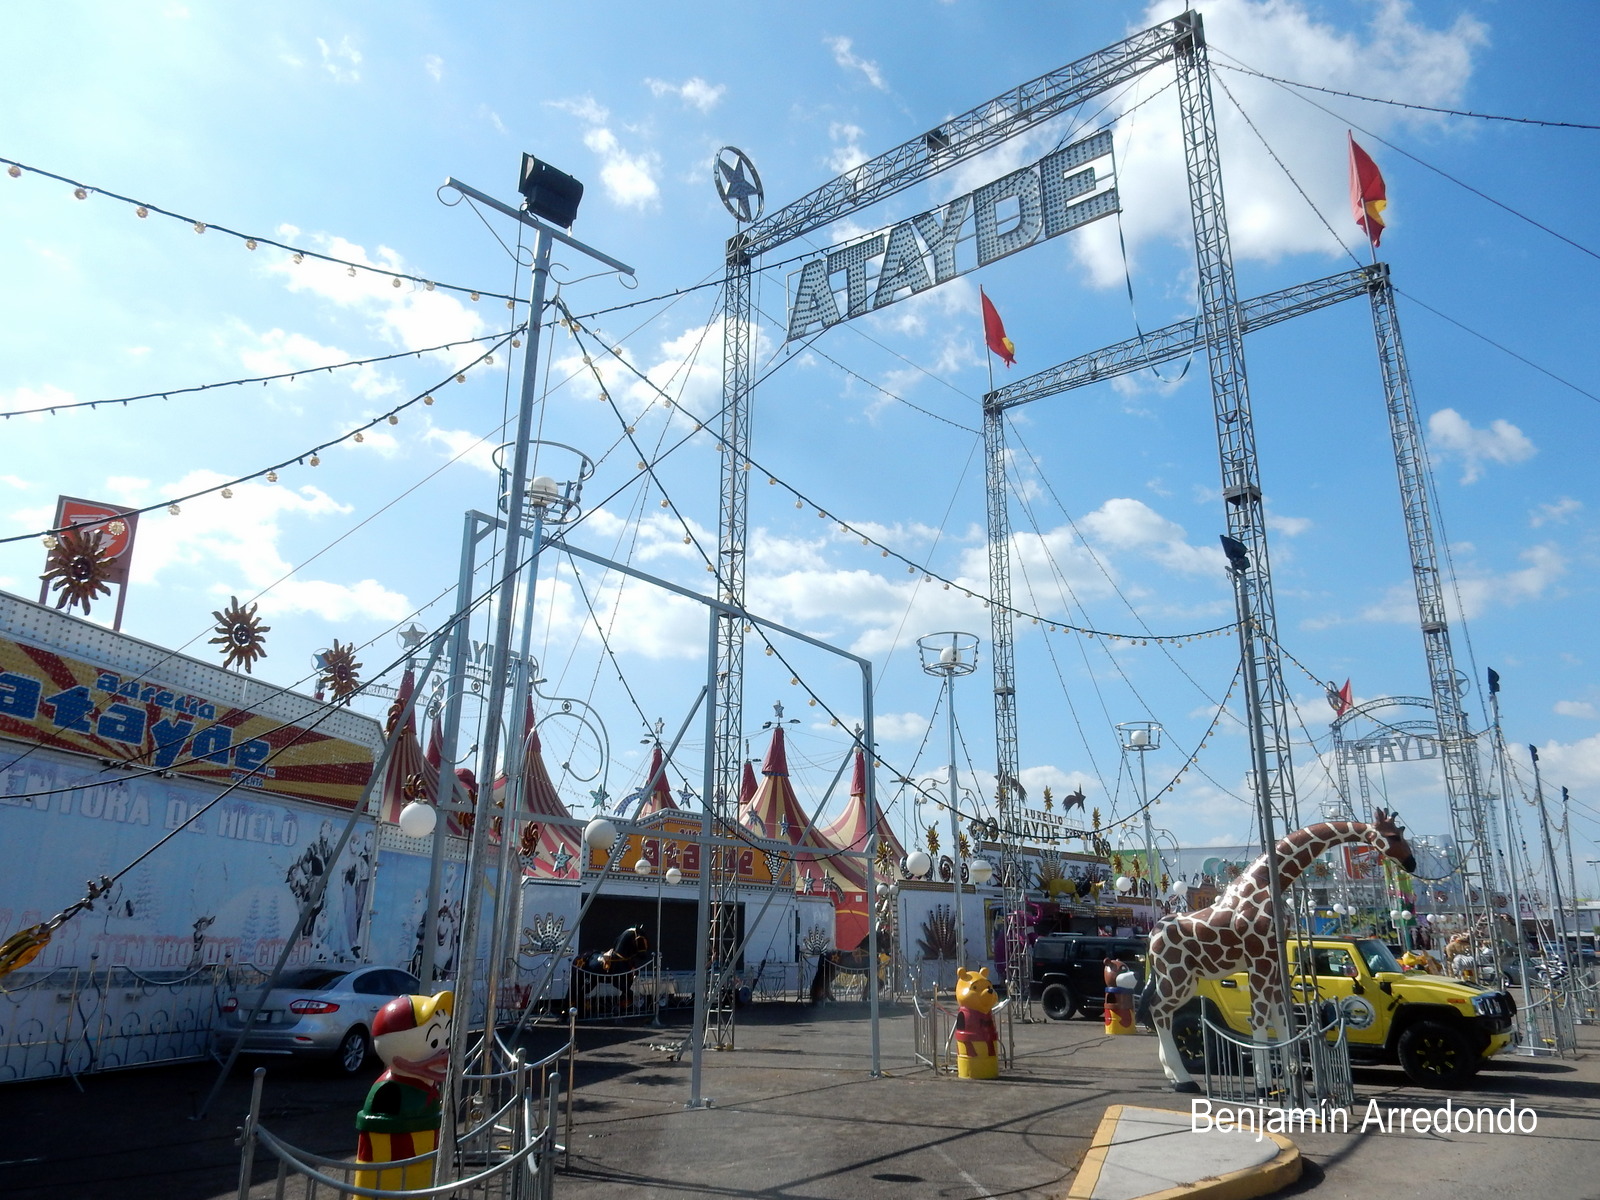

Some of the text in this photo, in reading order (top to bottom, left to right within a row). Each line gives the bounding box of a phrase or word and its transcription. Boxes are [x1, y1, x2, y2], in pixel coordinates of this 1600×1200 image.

[787, 130, 1120, 341] ATAYDE
[1341, 732, 1458, 766] ATAYD
[217, 801, 299, 847] HIELO
[1023, 808, 1064, 826] AURELIO
